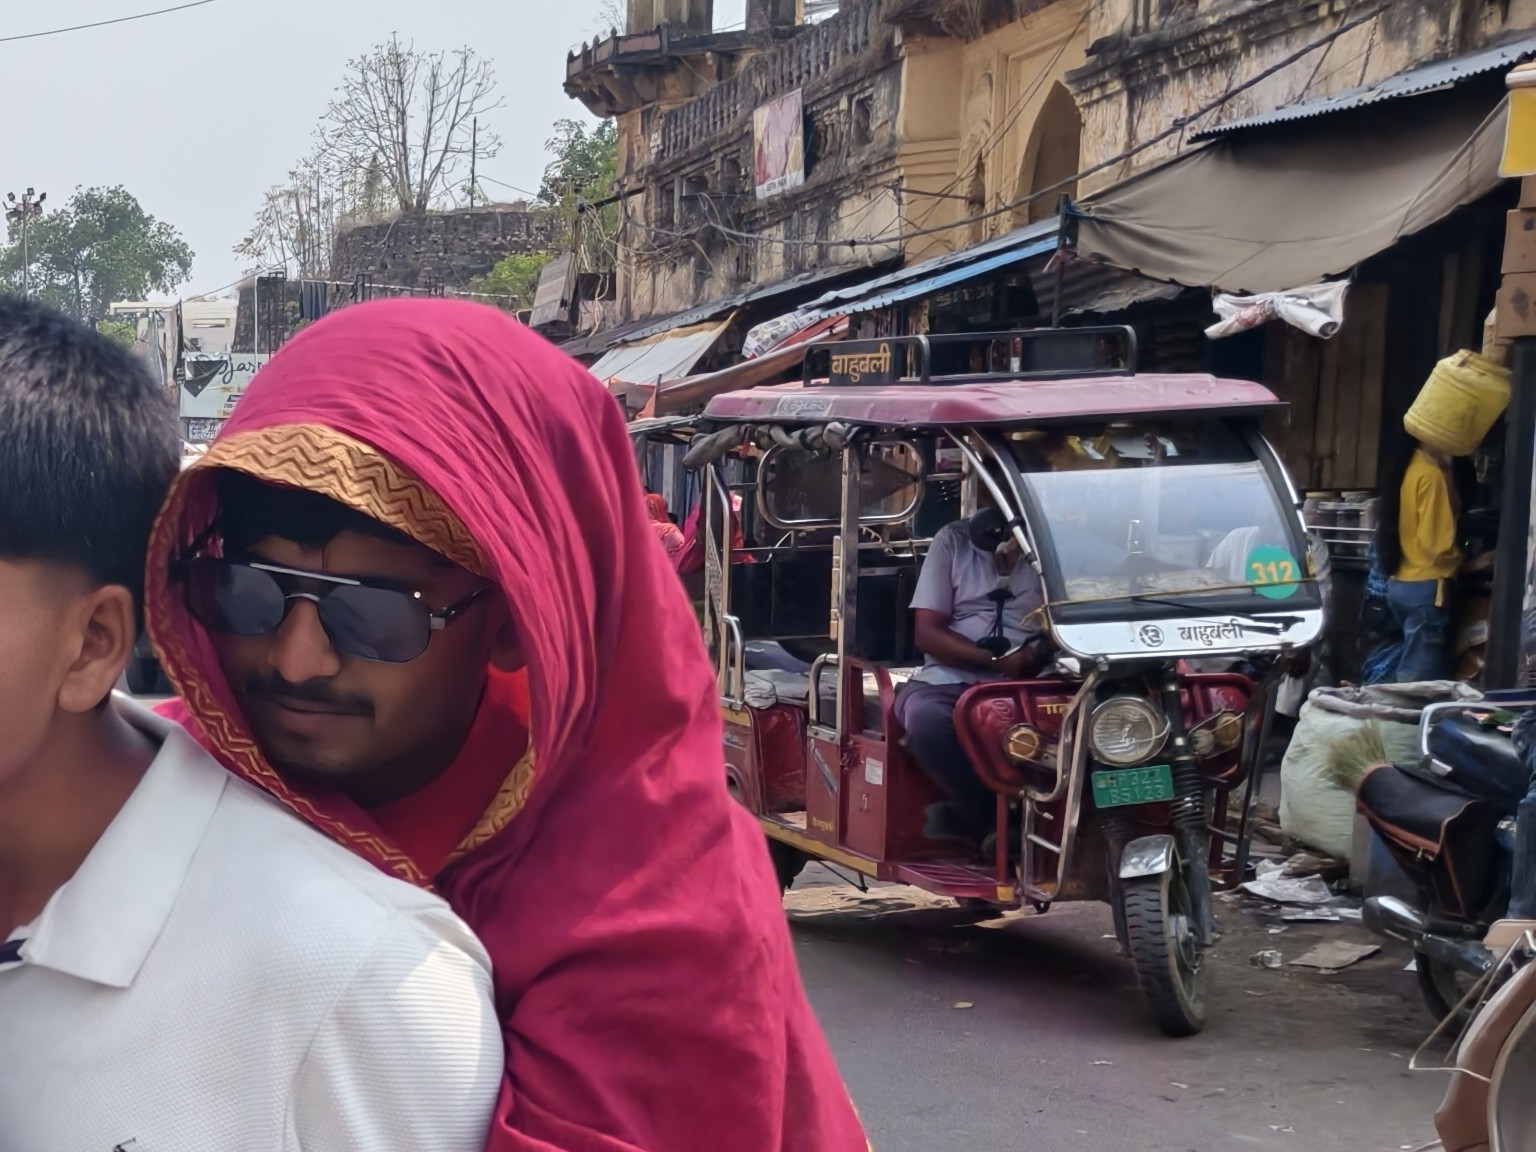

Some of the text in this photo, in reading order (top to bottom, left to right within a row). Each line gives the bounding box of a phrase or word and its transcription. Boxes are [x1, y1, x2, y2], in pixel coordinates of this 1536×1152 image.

[831, 343, 892, 383] बाहुबली
[1251, 561, 1293, 584] 312
[1177, 618, 1244, 647] बाहुबली
